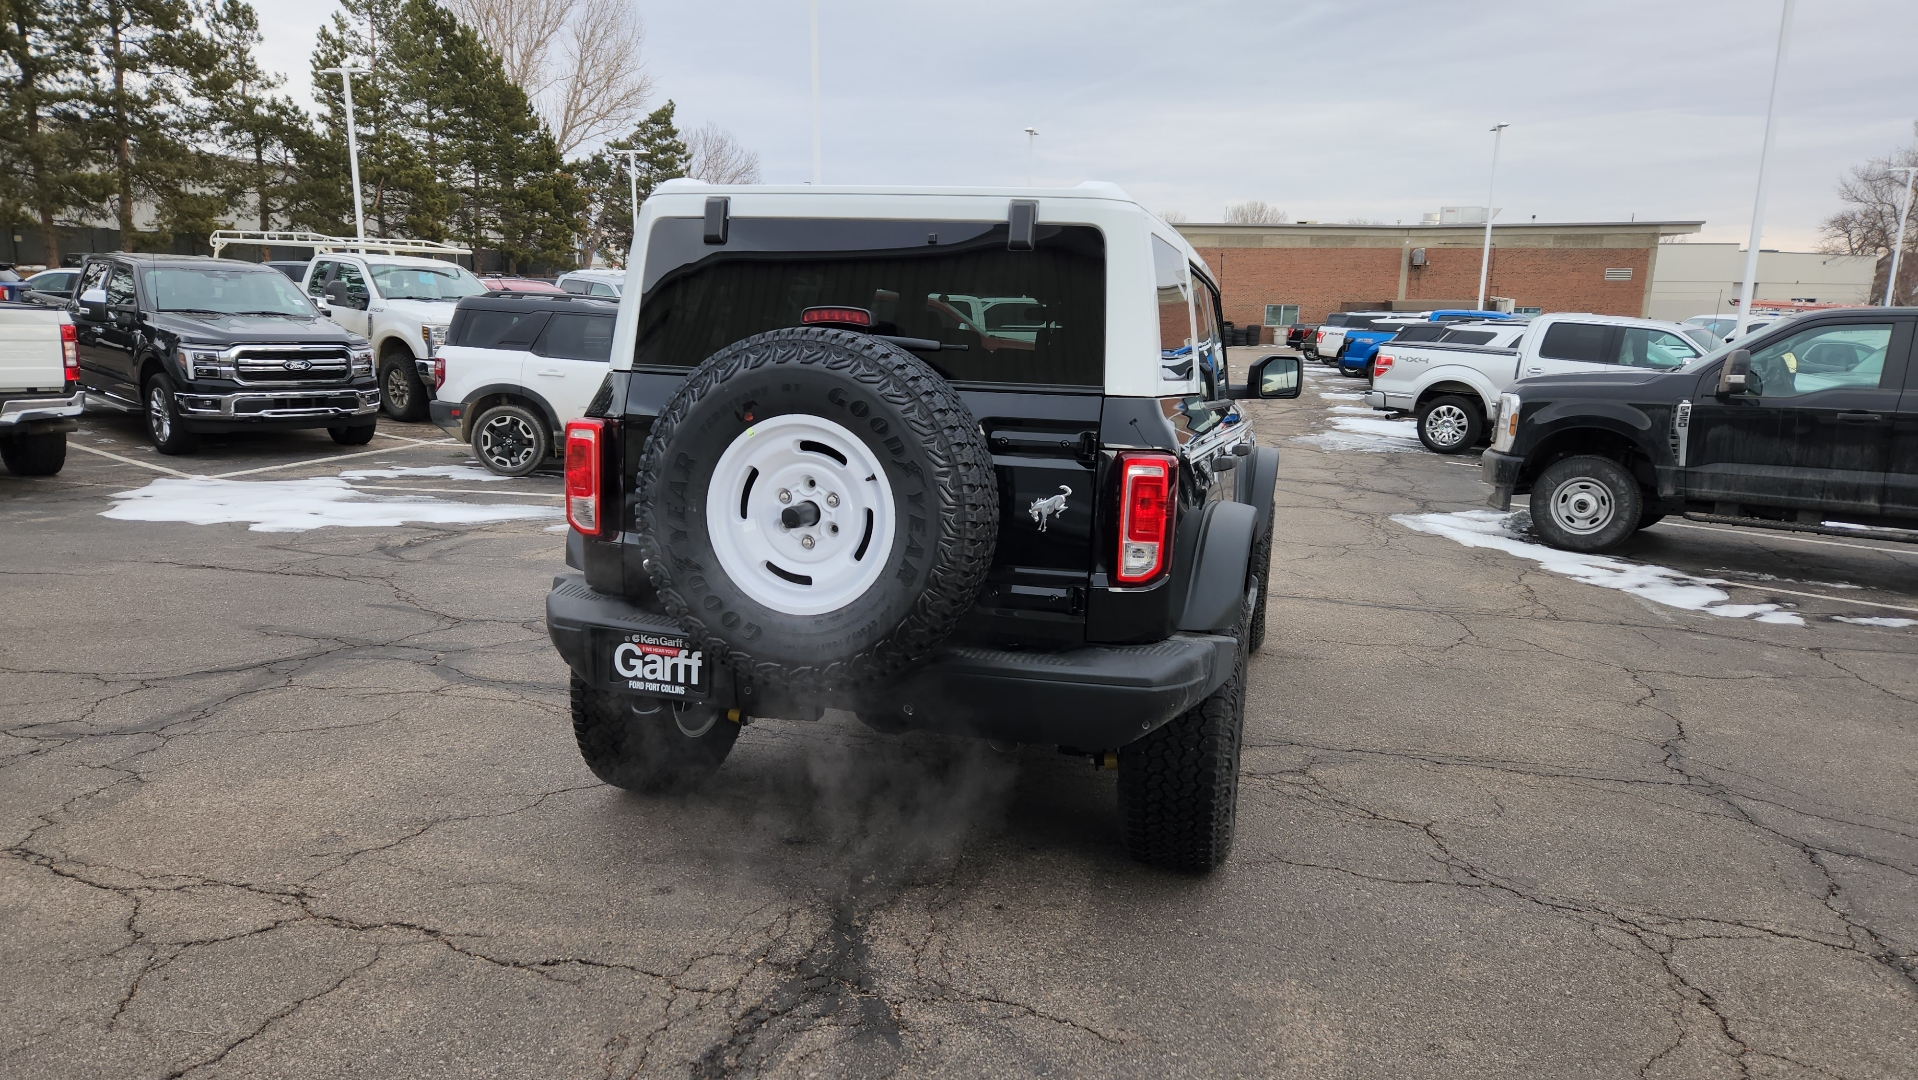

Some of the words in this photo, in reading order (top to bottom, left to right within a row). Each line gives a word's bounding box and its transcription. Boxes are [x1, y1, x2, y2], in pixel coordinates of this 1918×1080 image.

[826, 386, 928, 587] GOODYEAR
[640, 634, 660, 645] Ken
[660, 637, 683, 648] Garff
[614, 642, 702, 685] Garff
[628, 681, 645, 690] FORD
[645, 682, 660, 692] FORT
[660, 684, 686, 695] COLLINS
